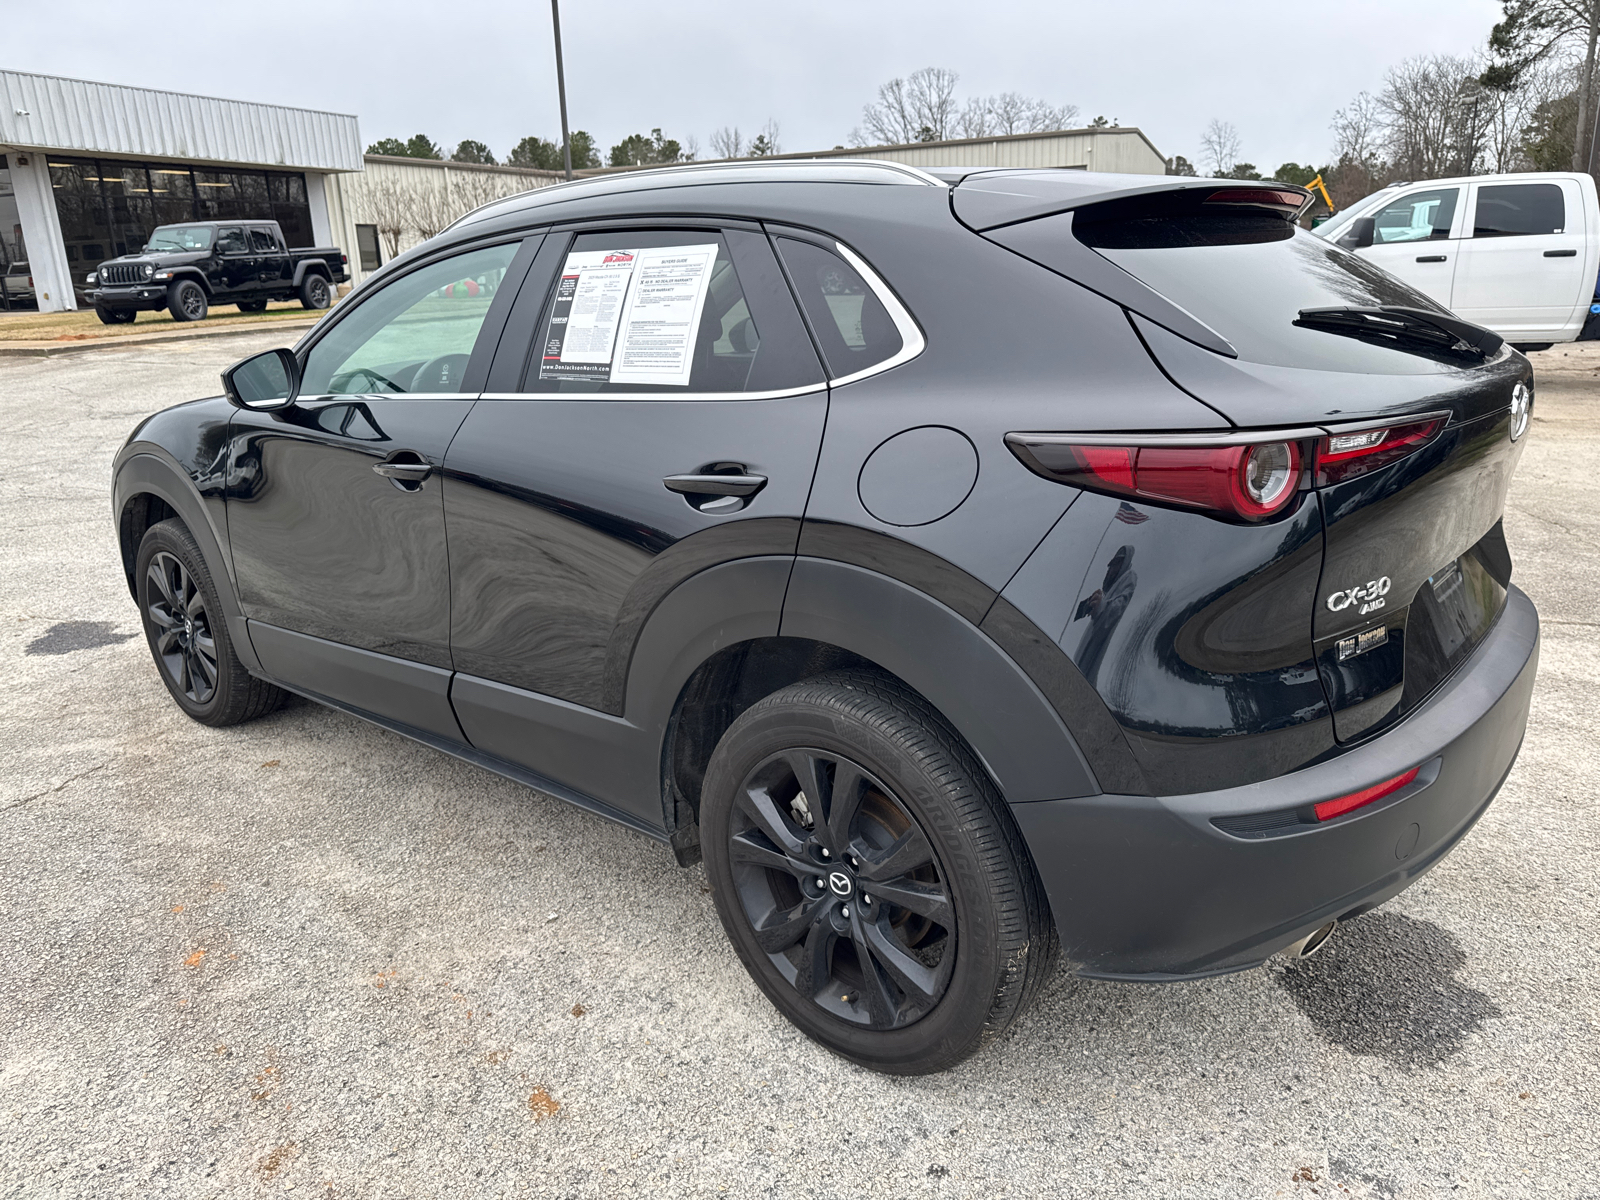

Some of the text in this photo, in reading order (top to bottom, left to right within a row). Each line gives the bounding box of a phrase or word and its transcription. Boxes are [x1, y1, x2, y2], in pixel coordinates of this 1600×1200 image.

[1326, 575, 1391, 612] CX-30
[1358, 597, 1386, 615] AWD
[911, 785, 990, 974] BRIDGESTONE
